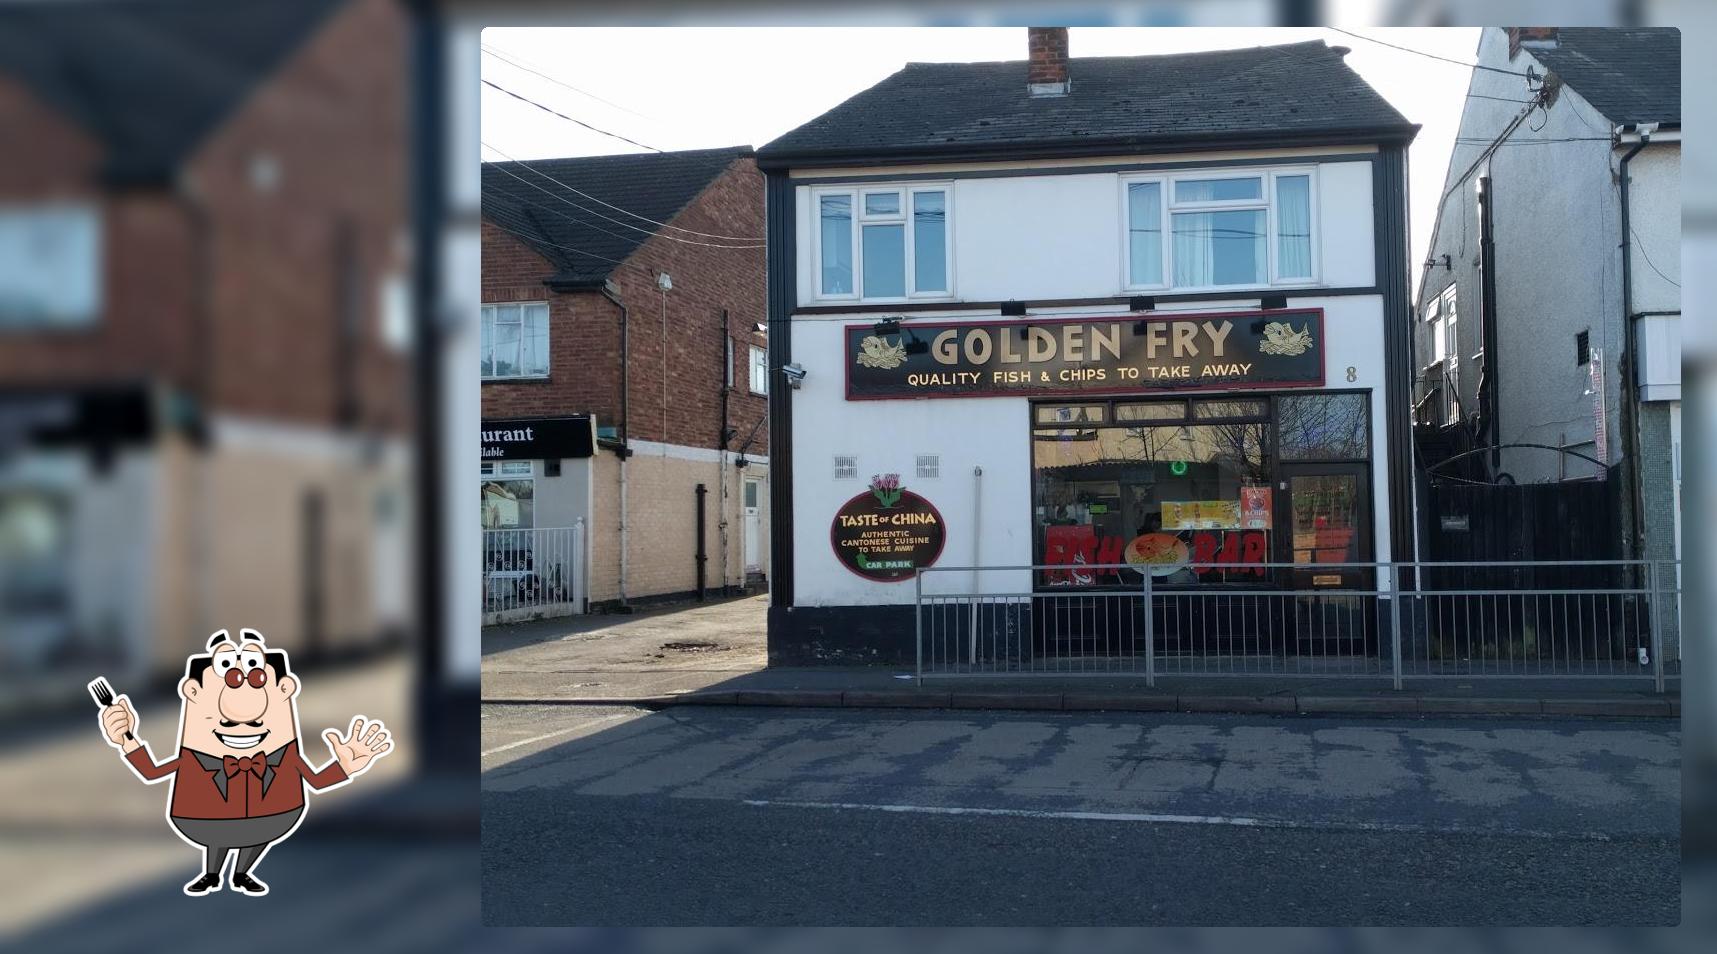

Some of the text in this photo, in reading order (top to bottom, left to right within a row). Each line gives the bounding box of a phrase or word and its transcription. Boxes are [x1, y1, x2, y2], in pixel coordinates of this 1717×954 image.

[932, 320, 1234, 365] GOLDEN FRY
[908, 363, 1253, 386] QUALITY FISH & CHIPS TO TAKE AWAY
[1346, 366, 1357, 382] 8
[480, 426, 534, 442] urant
[840, 514, 879, 527] TASTE
[891, 513, 936, 525] CHINA
[841, 537, 930, 547] CANTONESE CUISINE
[861, 530, 910, 538] AUTHENTIC
[1046, 536, 1124, 576] FISH
[1193, 532, 1266, 576] BAR
